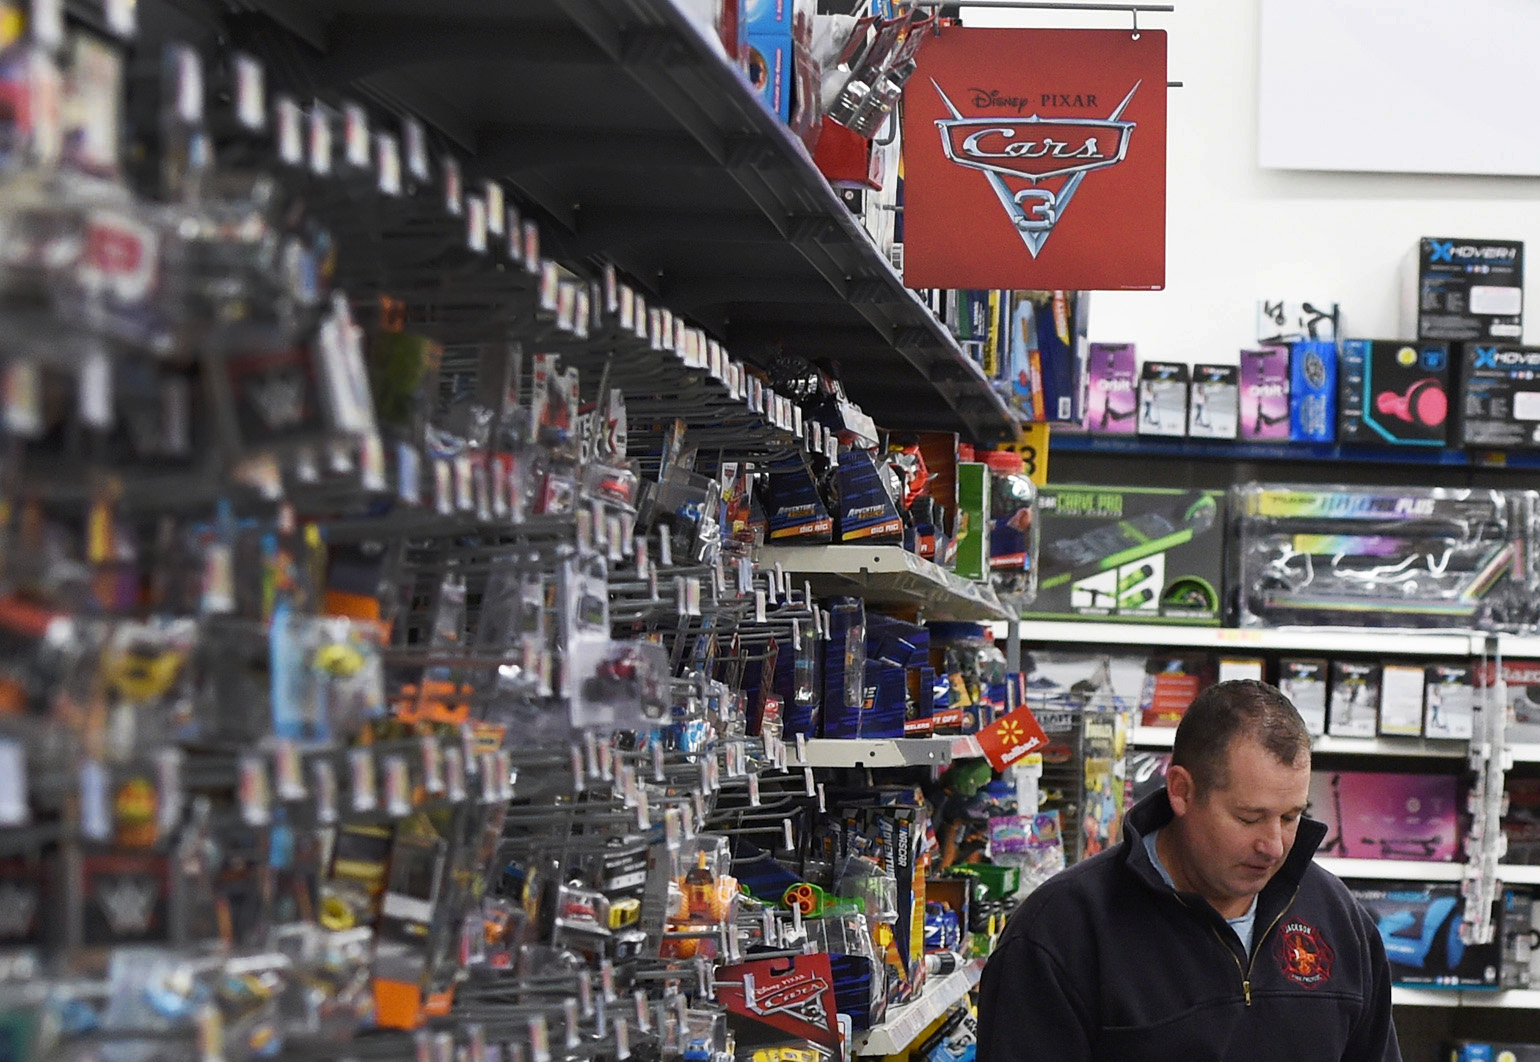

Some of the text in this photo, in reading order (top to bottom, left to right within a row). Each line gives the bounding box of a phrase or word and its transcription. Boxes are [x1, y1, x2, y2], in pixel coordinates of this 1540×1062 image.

[967, 87, 1099, 114] Disney PIXAR
[962, 127, 1104, 159] Cars
[1013, 188, 1057, 232] 3
[776, 503, 816, 515] ADVENTURE
[848, 503, 886, 517] ADVENTURE
[799, 524, 829, 534] BIG RIG
[870, 523, 899, 534] BIG RIG
[1000, 735, 1040, 764] Rollback
[897, 829, 909, 868] NASCAR
[1285, 923, 1312, 935] JACKSON
[756, 974, 806, 995] Disney PIXAR
